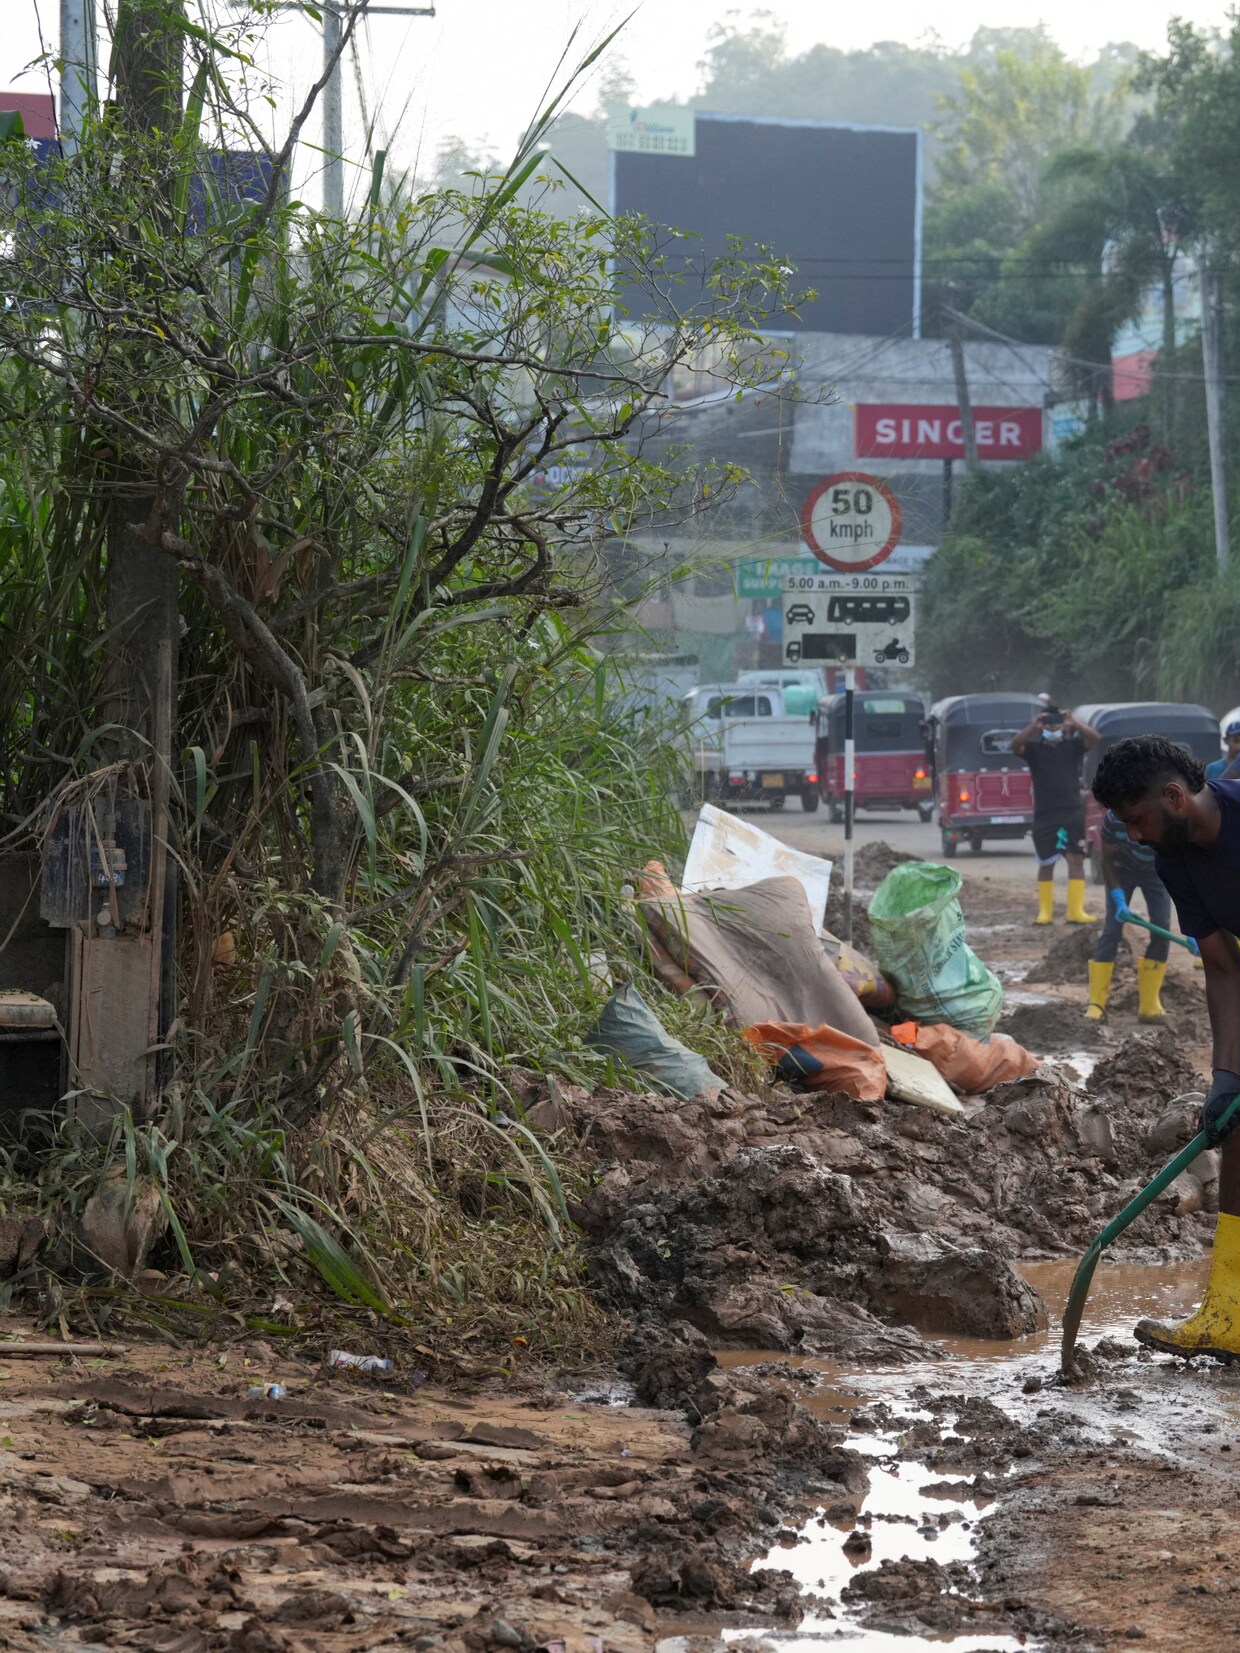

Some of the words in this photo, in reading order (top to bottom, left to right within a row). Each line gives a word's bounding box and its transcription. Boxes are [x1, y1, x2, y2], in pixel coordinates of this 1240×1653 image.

[831, 489, 873, 516] 50
[829, 519, 873, 542] kmph
[788, 577, 814, 589] 5.00
[882, 579, 909, 591] p.m.
